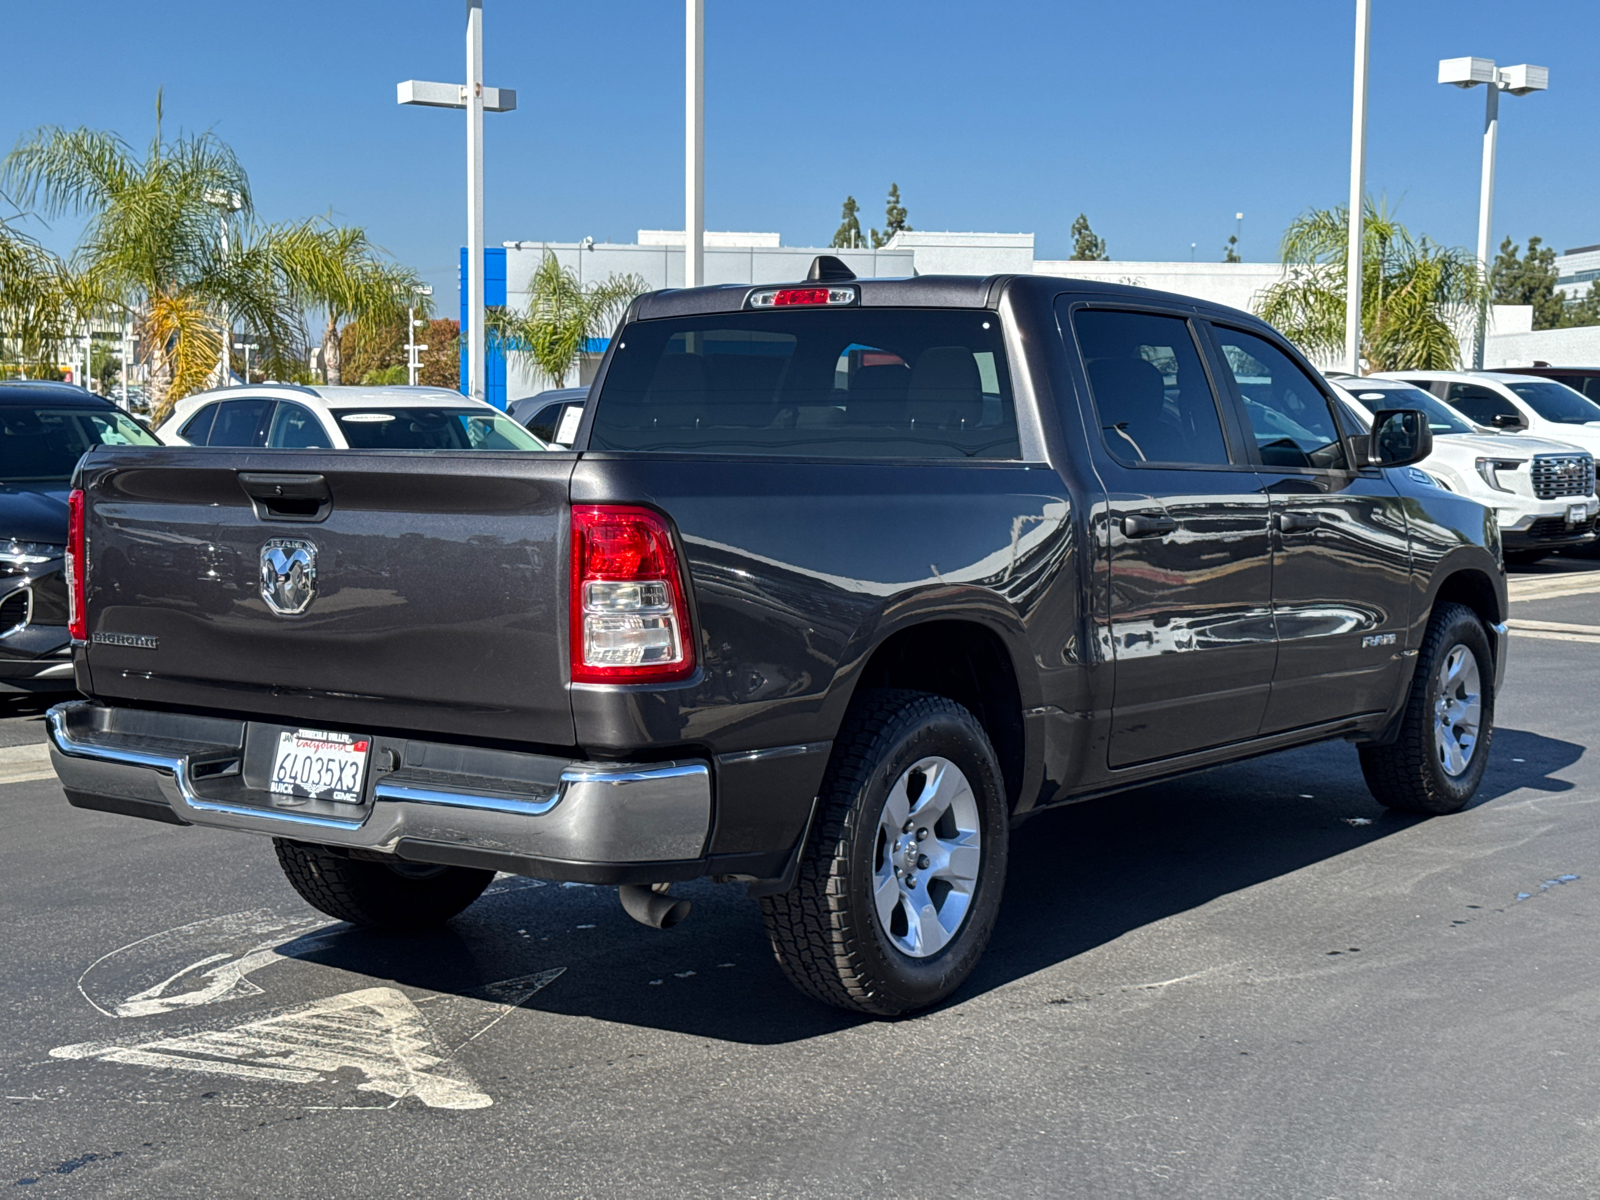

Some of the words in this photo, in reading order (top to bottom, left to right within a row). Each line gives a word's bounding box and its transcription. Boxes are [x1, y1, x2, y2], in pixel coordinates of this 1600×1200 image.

[1362, 633, 1396, 648] RAM
[277, 752, 359, 791] 64035X3
[271, 782, 294, 794] BUICK
[333, 791, 357, 802] GMC
